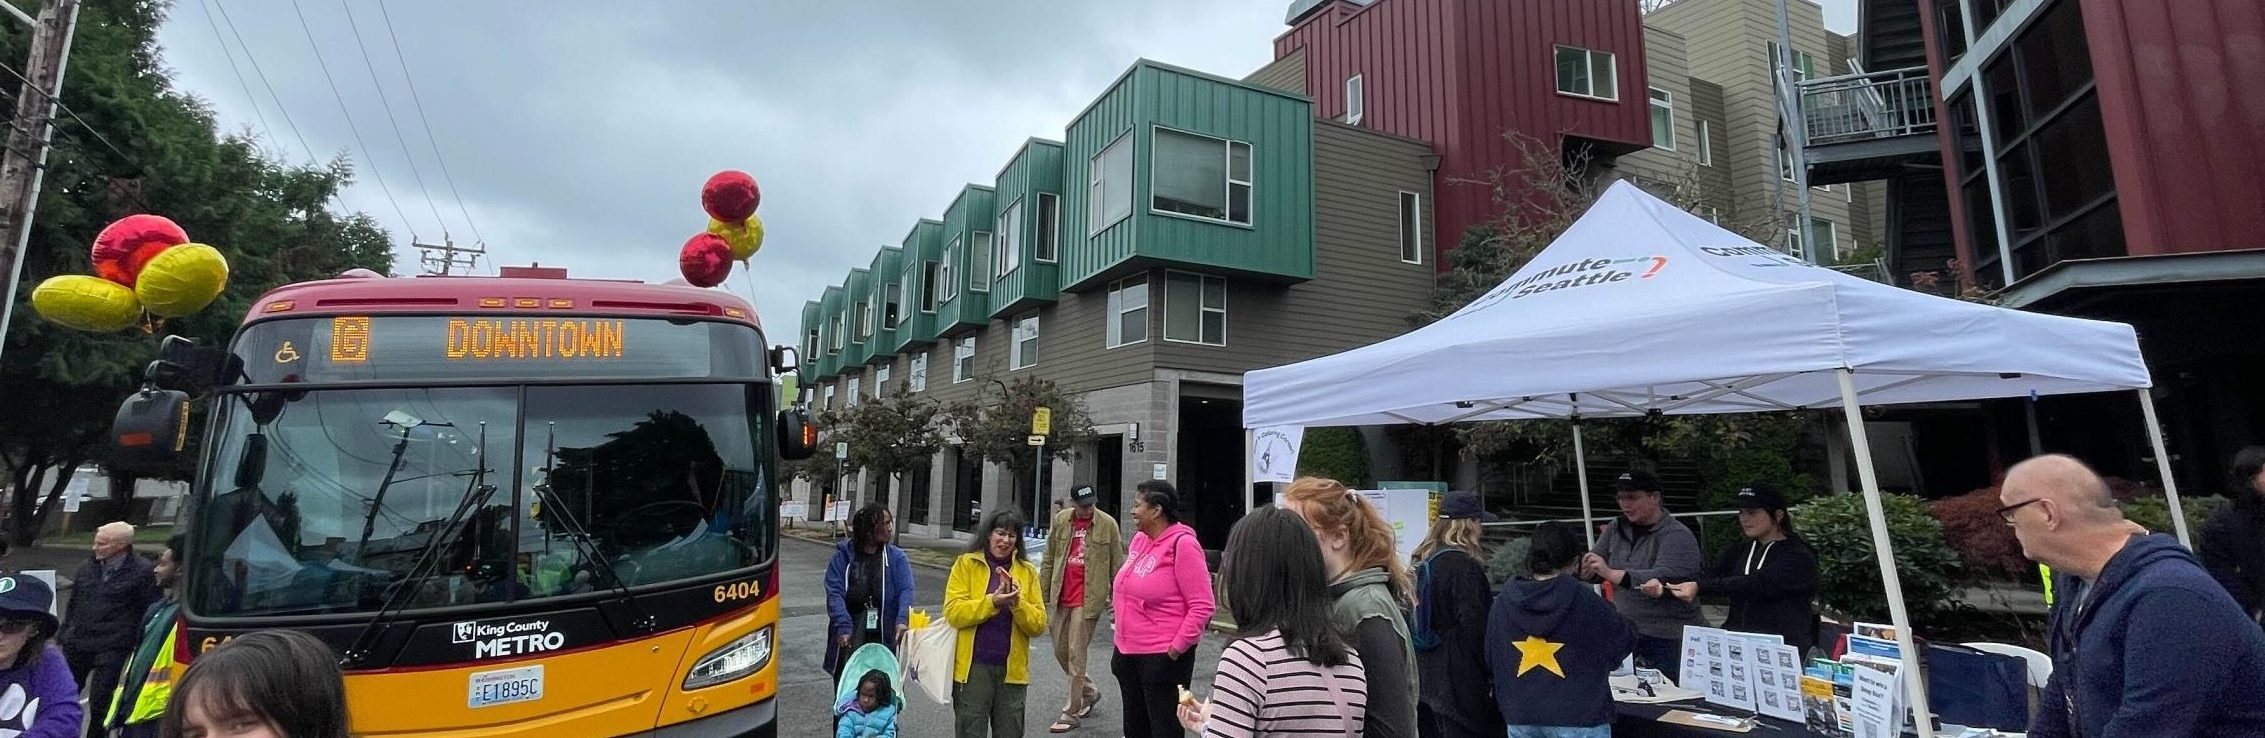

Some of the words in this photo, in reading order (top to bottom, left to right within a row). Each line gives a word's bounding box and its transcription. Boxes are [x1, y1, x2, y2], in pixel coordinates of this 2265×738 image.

[334, 318, 367, 359] G
[446, 319, 624, 358] DOWNTOWN
[714, 579, 760, 603] 6404
[476, 624, 506, 637] King
[506, 620, 550, 633] County
[475, 631, 565, 659] METRO
[482, 678, 538, 702] E1895C
